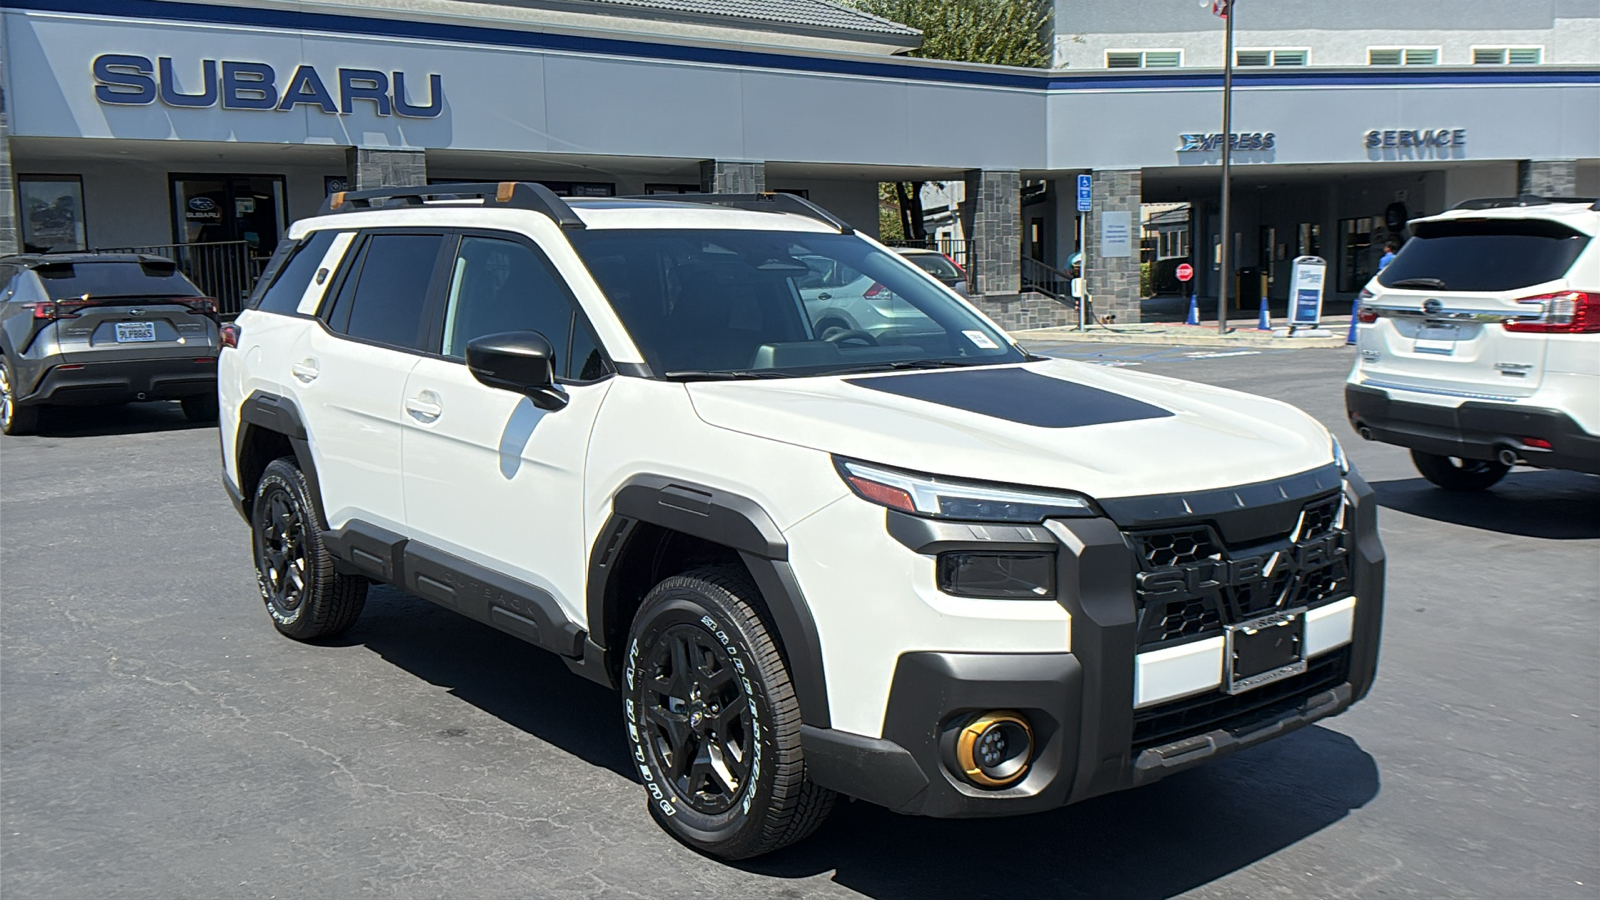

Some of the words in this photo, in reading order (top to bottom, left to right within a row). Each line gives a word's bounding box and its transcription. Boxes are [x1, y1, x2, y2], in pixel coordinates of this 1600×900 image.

[92, 53, 443, 118] SUBARU
[1179, 132, 1276, 151] EXPRESS
[1365, 129, 1466, 147] SERVICE
[1136, 528, 1350, 596] SUBARU
